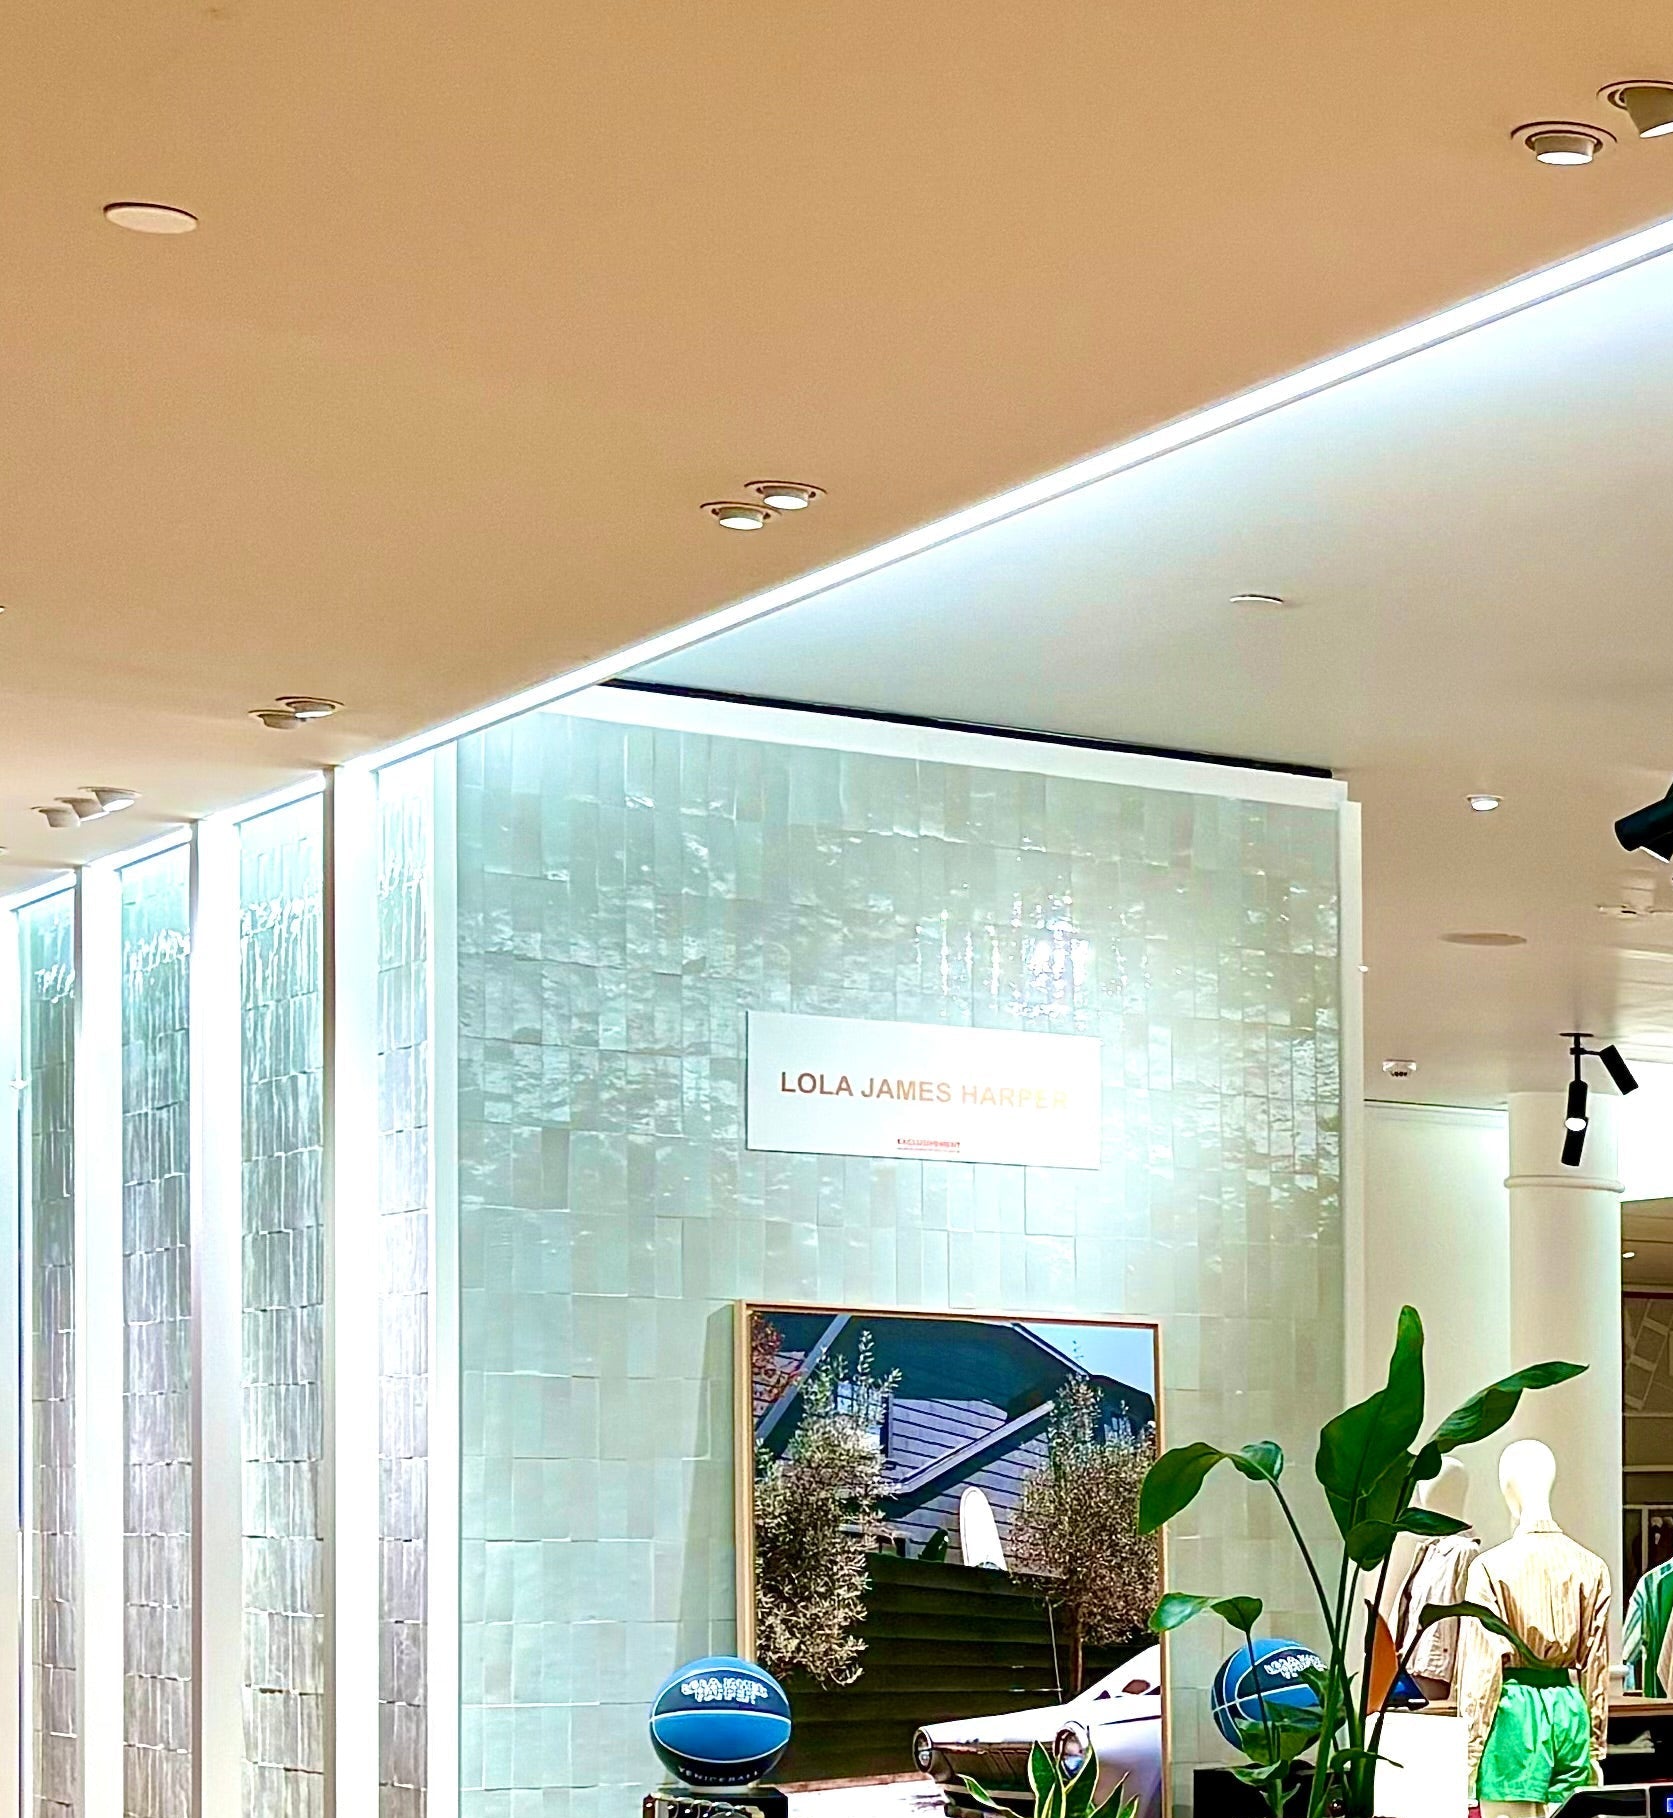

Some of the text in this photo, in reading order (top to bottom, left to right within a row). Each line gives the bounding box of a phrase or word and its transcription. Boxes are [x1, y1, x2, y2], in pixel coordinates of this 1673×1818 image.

[780, 1071, 1068, 1110] LOLA JAMES HARPER
